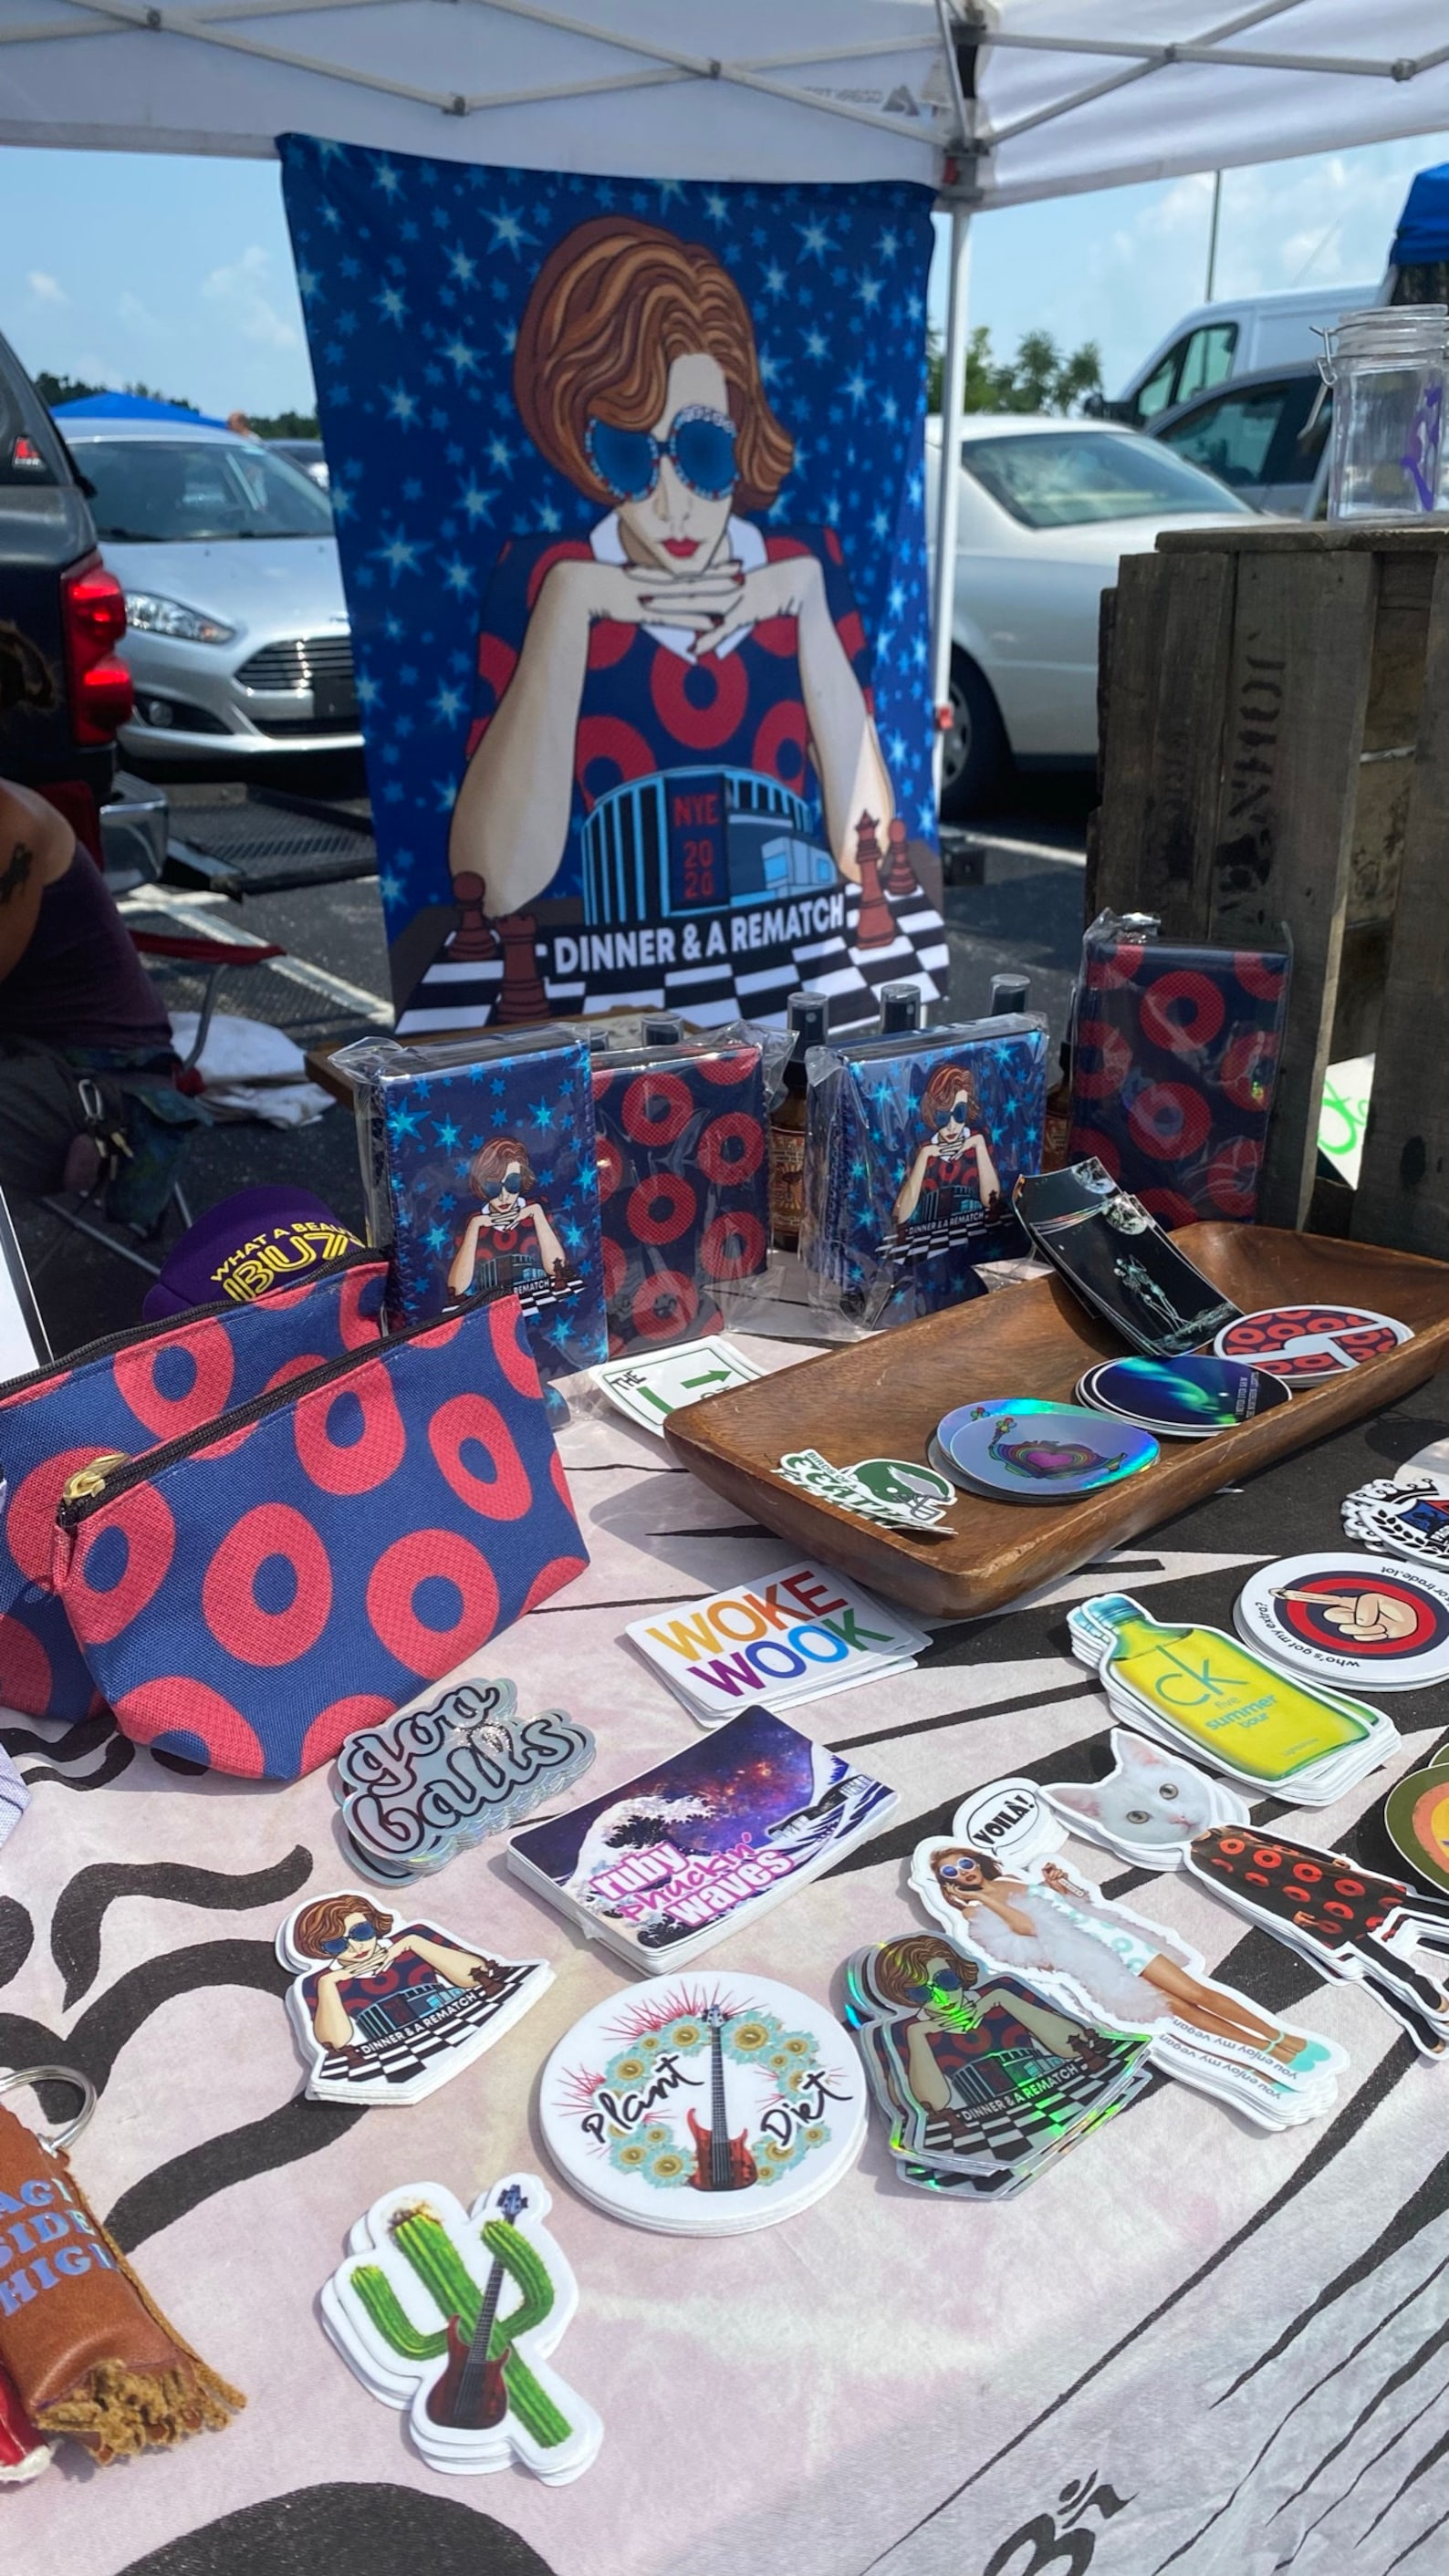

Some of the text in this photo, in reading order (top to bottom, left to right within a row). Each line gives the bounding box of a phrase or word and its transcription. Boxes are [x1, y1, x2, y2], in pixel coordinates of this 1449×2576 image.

[673, 795, 718, 827] NYE
[684, 839, 714, 867] 20
[684, 871, 714, 899] 20
[553, 893, 845, 974] DINNER & A REMATCH
[909, 1211, 985, 1234] DINNER & A REMATCH
[210, 1233, 267, 1282] WHAT
[274, 1227, 290, 1240] A
[513, 1278, 550, 1295] REMATCH
[611, 1369, 647, 1391] THE
[807, 1451, 837, 1475] BIRDS
[644, 1570, 849, 1661] WOKE
[1255, 1602, 1360, 1667] who's got my extra?
[686, 1607, 895, 1698] WOOK
[1204, 1693, 1277, 1730] summer
[973, 1794, 1036, 1844] VOILÀ!
[590, 1841, 689, 1900] ruby
[664, 1849, 795, 1927] waves
[360, 2031, 406, 2055] DINNER
[403, 2026, 416, 2038] &
[413, 2022, 426, 2034] A
[422, 1991, 477, 2029] REMATCH
[1173, 2018, 1298, 2080] you enjoy my vegan
[962, 2098, 1007, 2122] DINNER
[1005, 2094, 1016, 2107] &
[1013, 2092, 1026, 2104] A
[1024, 2063, 1079, 2099] REMATCH
[1159, 2033, 1282, 2100] you enjoy my vegan
[581, 2054, 704, 2144] Plant
[760, 2071, 854, 2147] Diet
